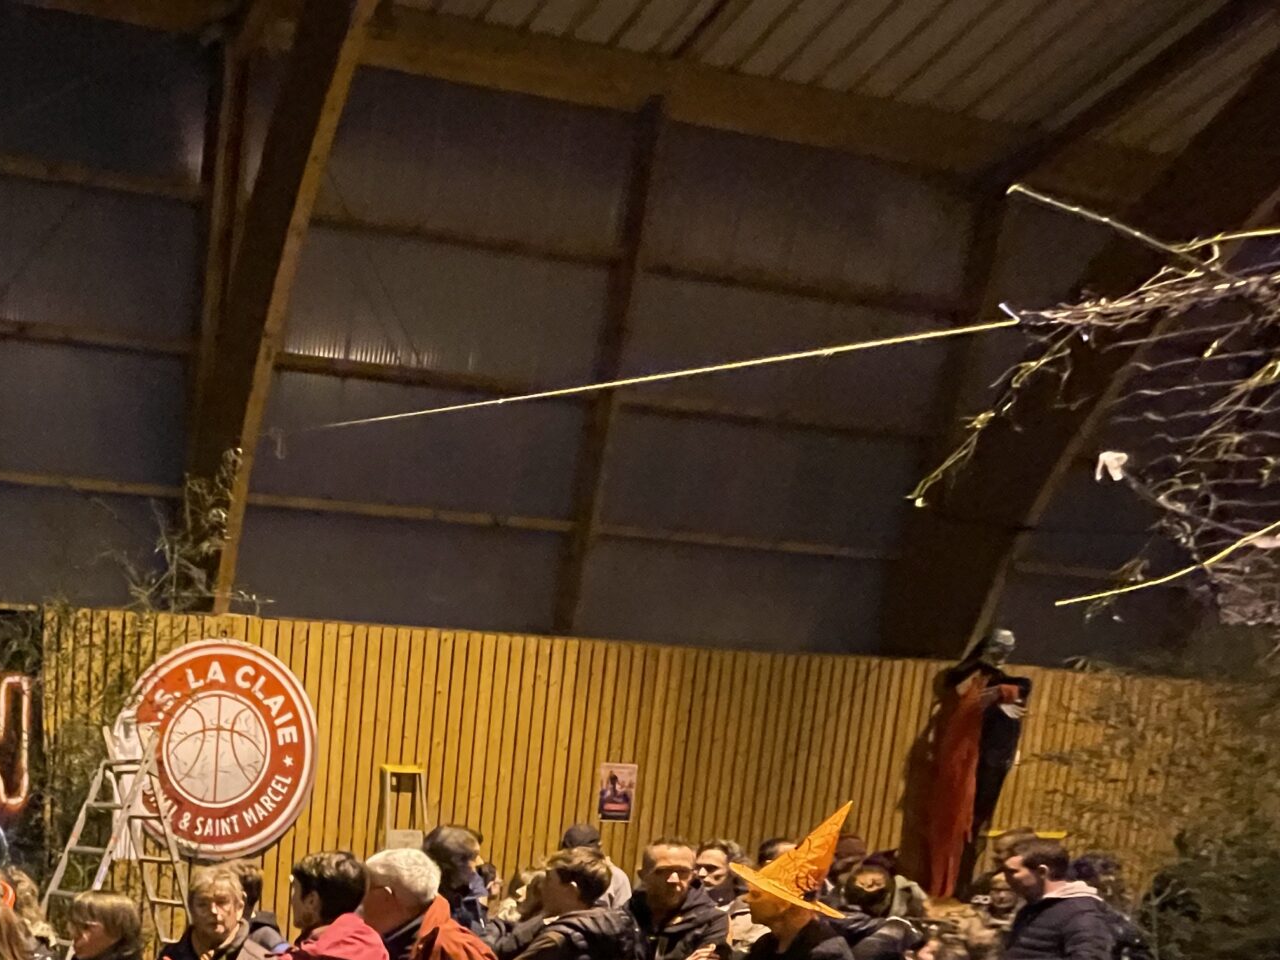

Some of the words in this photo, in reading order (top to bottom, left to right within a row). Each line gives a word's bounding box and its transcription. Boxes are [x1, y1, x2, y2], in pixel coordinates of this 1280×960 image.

[185, 661, 226, 689] LA
[235, 665, 298, 746] CLAIE
[178, 811, 192, 832] &
[194, 814, 239, 838] SAINT
[242, 774, 293, 829] MARCEL
